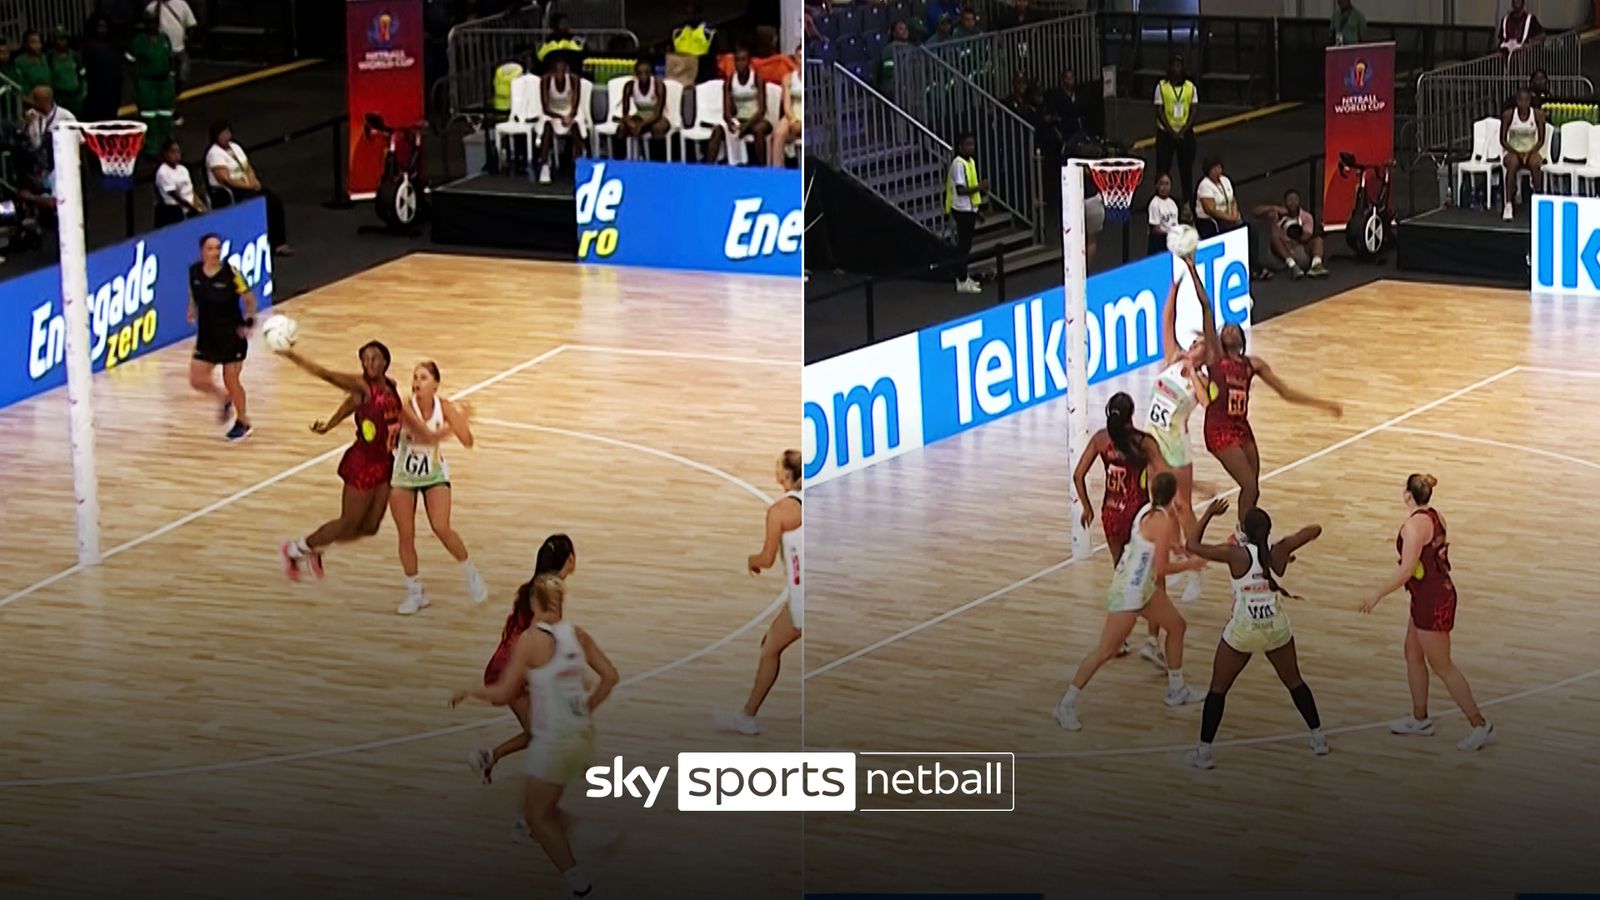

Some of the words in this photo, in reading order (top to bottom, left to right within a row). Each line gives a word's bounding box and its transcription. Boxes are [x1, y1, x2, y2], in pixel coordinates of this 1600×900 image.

[1334, 103, 1367, 113] WORLD
[1368, 101, 1386, 111] CUP
[1342, 94, 1377, 106] NETBALL
[576, 163, 623, 224] de
[578, 227, 619, 258] ro
[29, 240, 158, 380] Engade
[105, 308, 157, 370] zero
[1150, 403, 1169, 427] GS
[405, 453, 430, 476] GA
